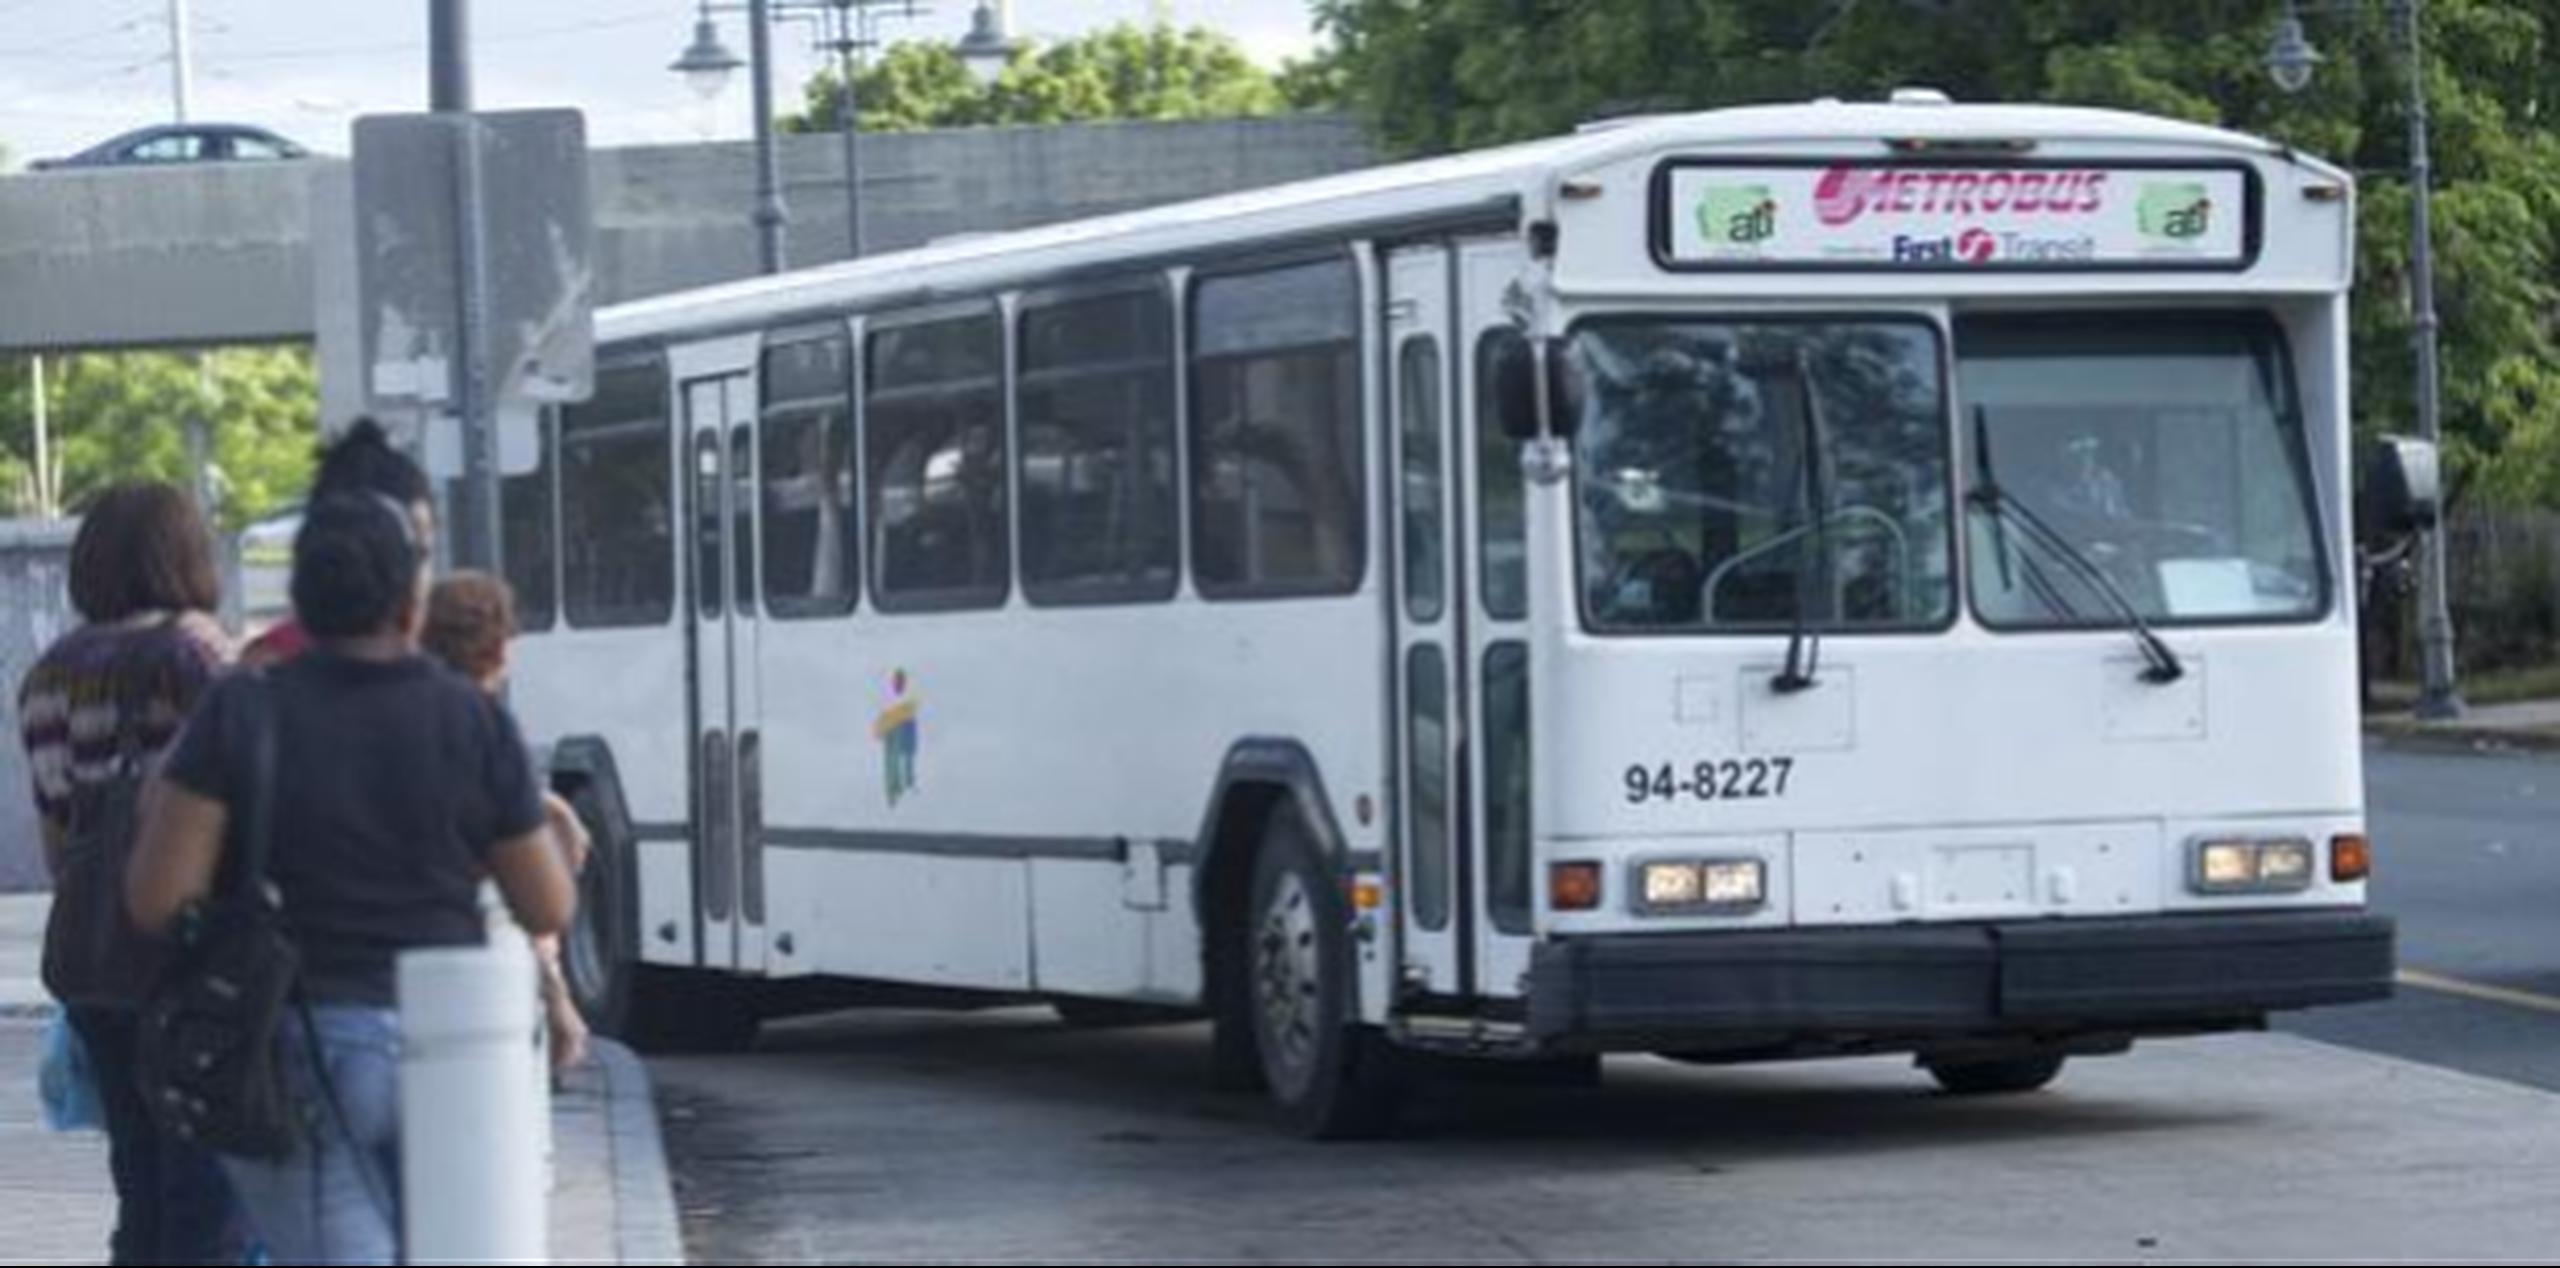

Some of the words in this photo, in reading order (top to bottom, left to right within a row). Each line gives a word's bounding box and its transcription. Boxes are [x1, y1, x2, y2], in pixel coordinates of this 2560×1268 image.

[1815, 163, 2107, 225] METROBUS
[1893, 235, 1952, 261] First
[2001, 232, 2094, 261] Transit
[1623, 756, 1793, 804] 94-8227
